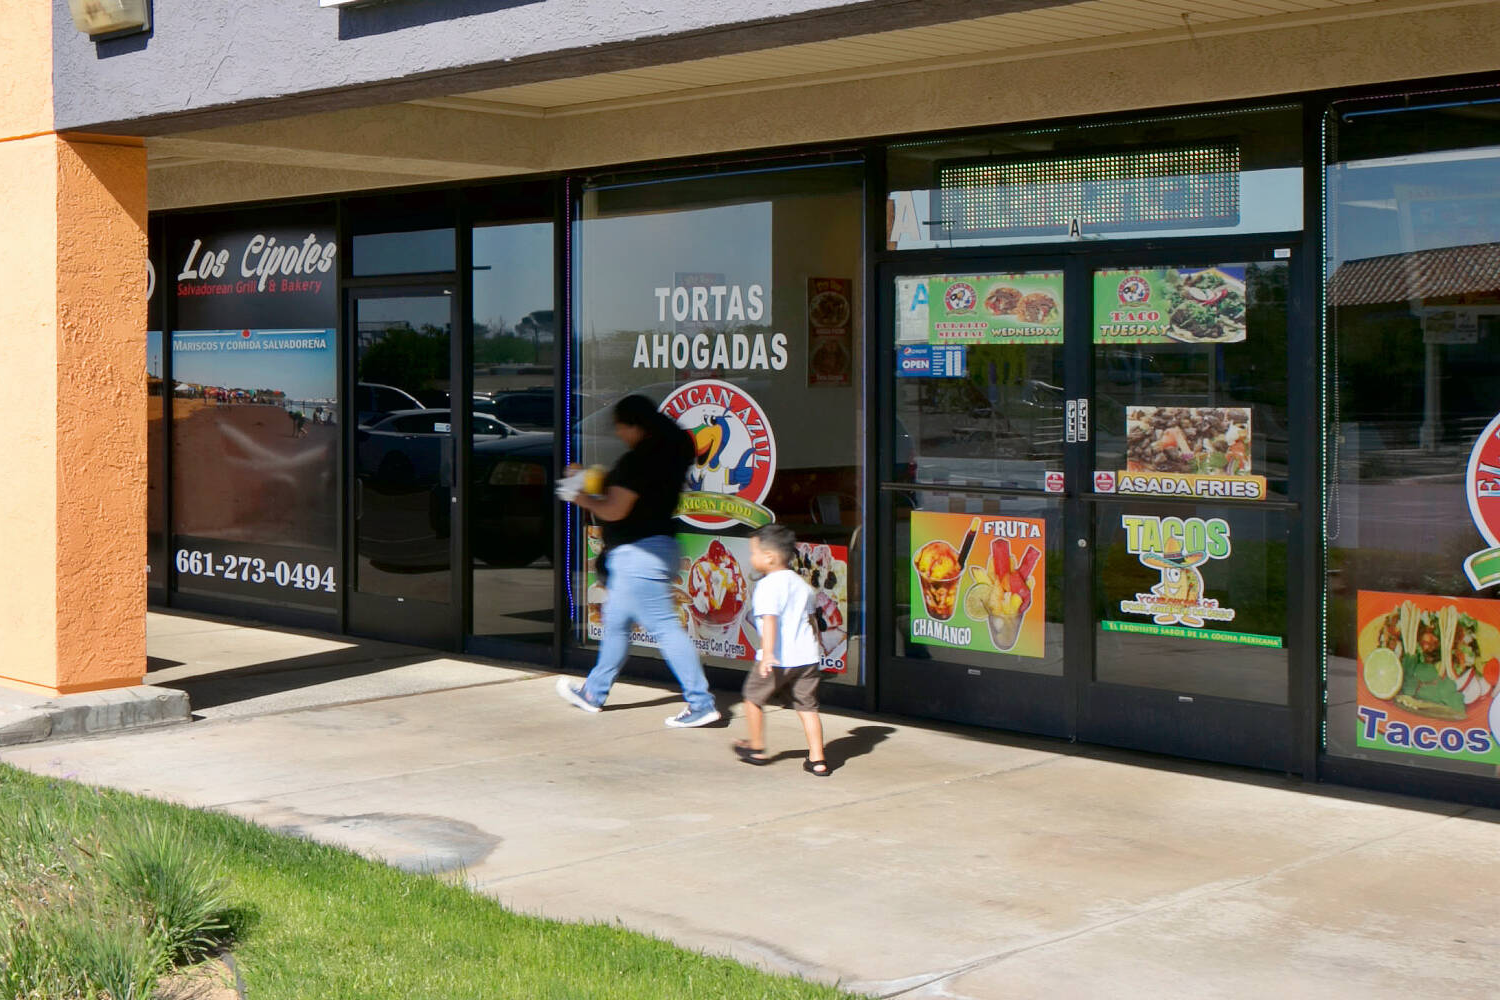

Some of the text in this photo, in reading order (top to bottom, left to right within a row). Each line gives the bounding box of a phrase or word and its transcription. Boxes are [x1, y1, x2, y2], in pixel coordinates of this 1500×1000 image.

[1071, 218, 1080, 238] A
[177, 233, 337, 292] Los Cipotes
[177, 279, 322, 297] Salvadorean Grill & Bakery
[655, 284, 765, 322] TORTAS
[1109, 311, 1160, 322] TACO
[991, 327, 1061, 338] WEDNESDAY
[1100, 324, 1171, 337] TUESDAY
[173, 337, 327, 351] MARISCOS Y COMIDA SALVADOREÑA
[633, 333, 788, 371] AHOGADAS
[902, 360, 930, 369] OPEN
[1068, 402, 1076, 433] PULL
[1079, 402, 1087, 431] PULL
[736, 407, 771, 469] AZUL
[1118, 476, 1193, 495] ASADA
[1195, 480, 1261, 499] FRIES
[720, 502, 753, 517] FOOD
[982, 520, 1042, 540] FRUTA
[1122, 515, 1232, 559] TACOS
[175, 549, 337, 592] 661-273-0494
[912, 619, 972, 646] CHAMANGO
[1199, 631, 1209, 639] LA
[711, 638, 723, 651] Con
[724, 640, 745, 655] Crema
[1359, 707, 1492, 752] Tacos
